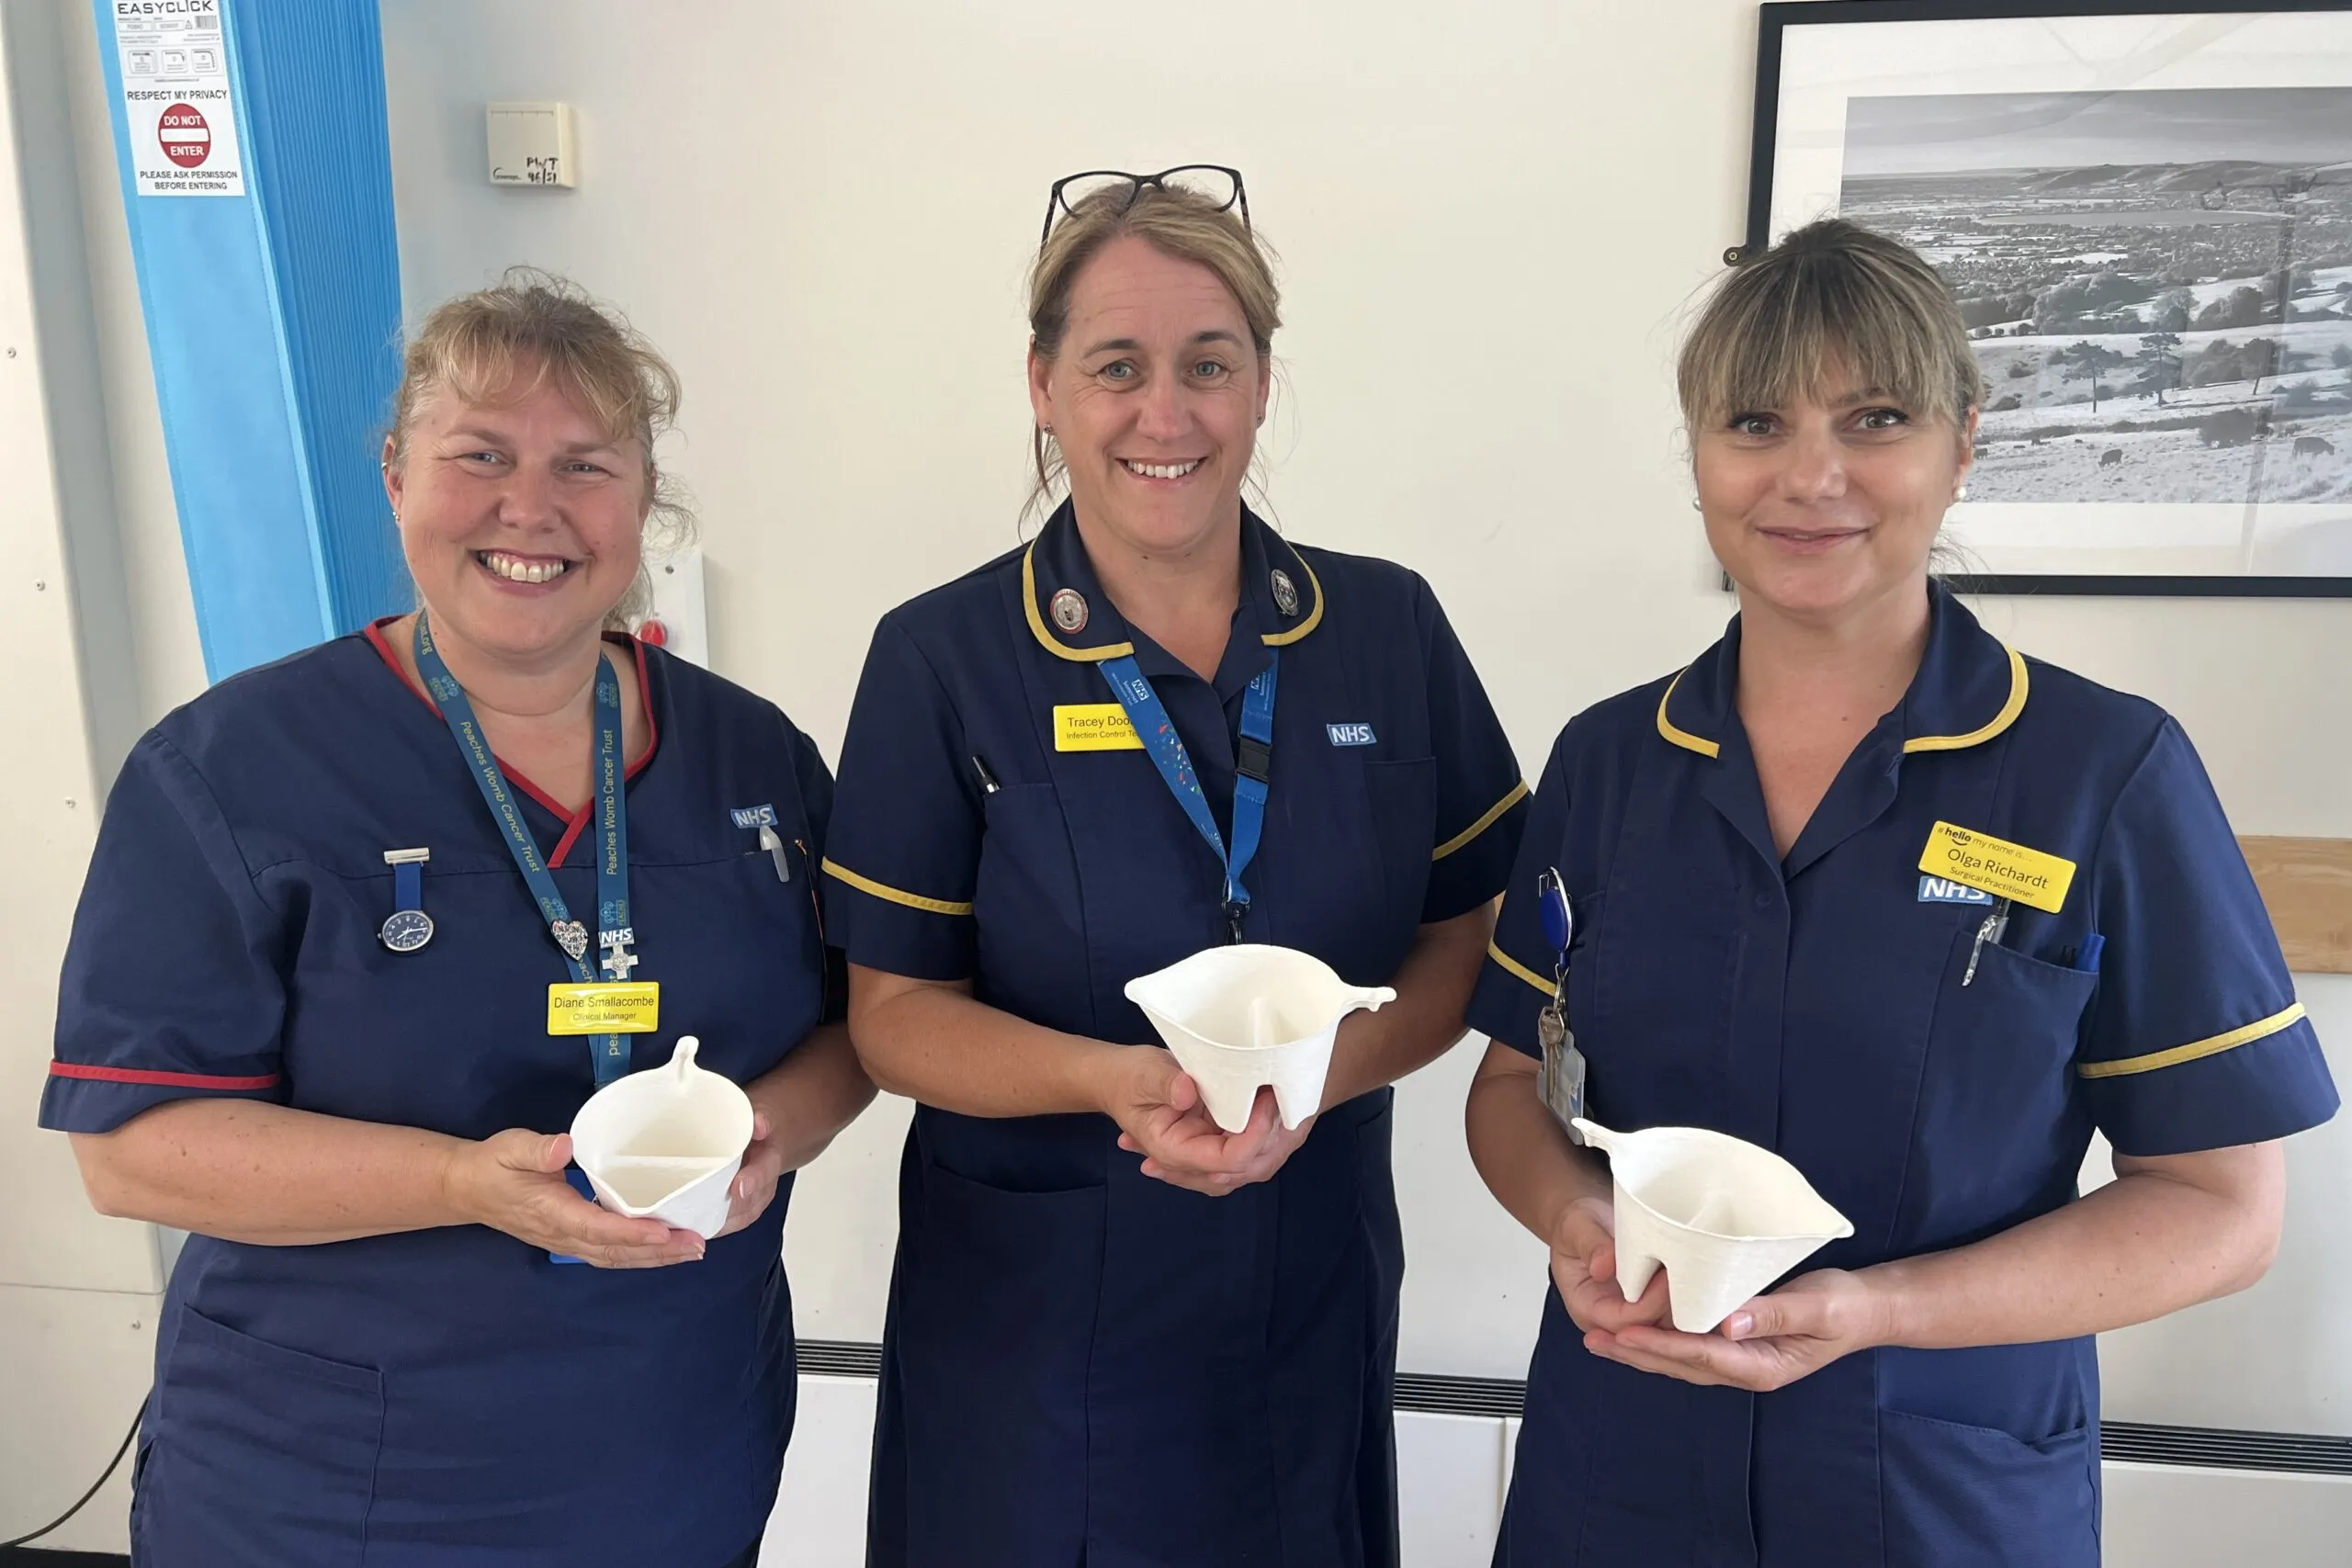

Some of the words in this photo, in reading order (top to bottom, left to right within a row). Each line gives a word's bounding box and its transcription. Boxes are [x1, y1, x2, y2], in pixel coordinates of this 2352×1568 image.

[118, 0, 214, 14] EASYCLICK
[127, 91, 172, 100] RESPECT
[175, 91, 187, 100] MY
[189, 89, 227, 99] PRIVACY
[164, 115, 179, 126] DO
[181, 115, 201, 126] NOT
[170, 146, 204, 156] ENTER
[140, 171, 172, 179] PLEASE
[174, 171, 189, 179] ASK
[154, 182, 187, 190] BEFORE
[188, 182, 228, 190] ENTERING
[1131, 681, 1148, 700] NHS
[1068, 717, 1104, 728] Tracey
[1108, 716, 1133, 726] Doo
[603, 729, 612, 755] Trust
[1067, 731, 1098, 739] Infection
[1099, 730, 1126, 739] Control
[1331, 726, 1370, 743] NHS
[603, 757, 614, 795] Cancer
[460, 721, 487, 765] Peaches
[483, 767, 505, 802] Womb
[501, 804, 526, 843] Cancer
[521, 845, 540, 873] Trust
[604, 795, 615, 829] Womb
[735, 807, 772, 827] NHS
[606, 830, 617, 875] Peaches
[1973, 838, 1988, 849] my
[1988, 842, 2014, 855] name
[1948, 849, 1982, 869] Olga
[1984, 859, 2049, 890] Richardt
[1949, 866, 1984, 882] Surgical
[1984, 877, 2035, 899] Practitioner
[601, 928, 632, 944] NHS
[554, 997, 584, 1009] Diane
[587, 997, 654, 1009] Smallacombe
[572, 1012, 602, 1021] Clinical
[603, 1011, 637, 1021] Manager
